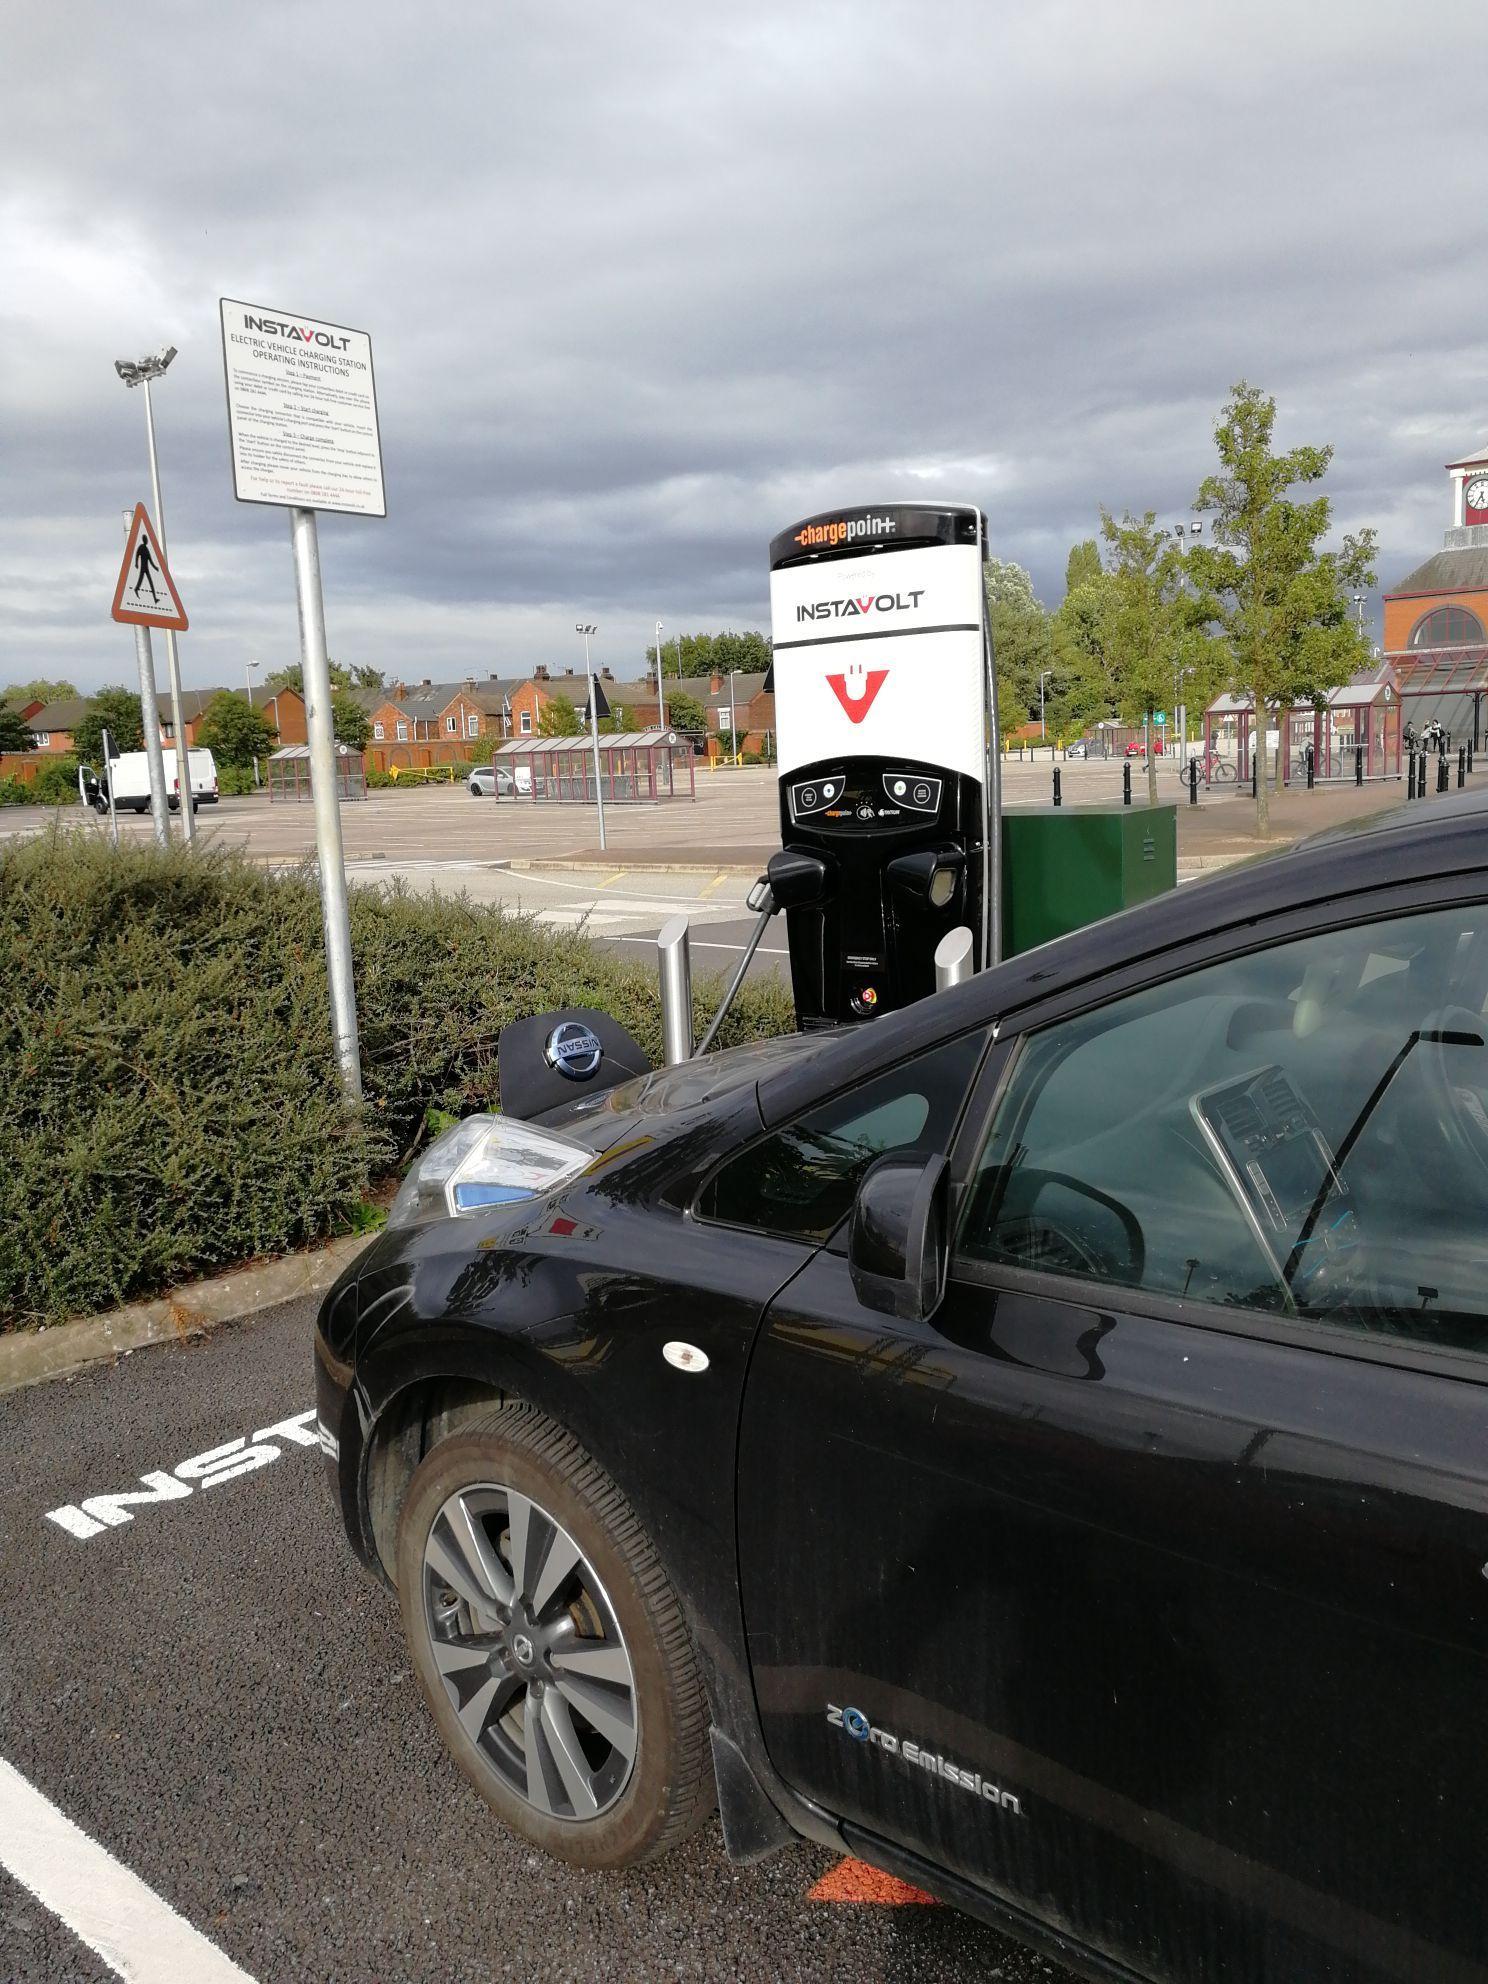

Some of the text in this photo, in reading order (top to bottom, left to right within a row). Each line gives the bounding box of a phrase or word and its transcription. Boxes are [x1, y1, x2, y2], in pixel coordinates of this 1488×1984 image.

[244, 314, 351, 351] INSTAVOLT
[230, 333, 367, 371] ELECTRIC VEHICLE CHARGING STATION
[252, 349, 350, 377] OPERATING INSTRUCTIONS
[796, 590, 926, 622] INSTAVOLT
[557, 1038, 599, 1055] NISSAN
